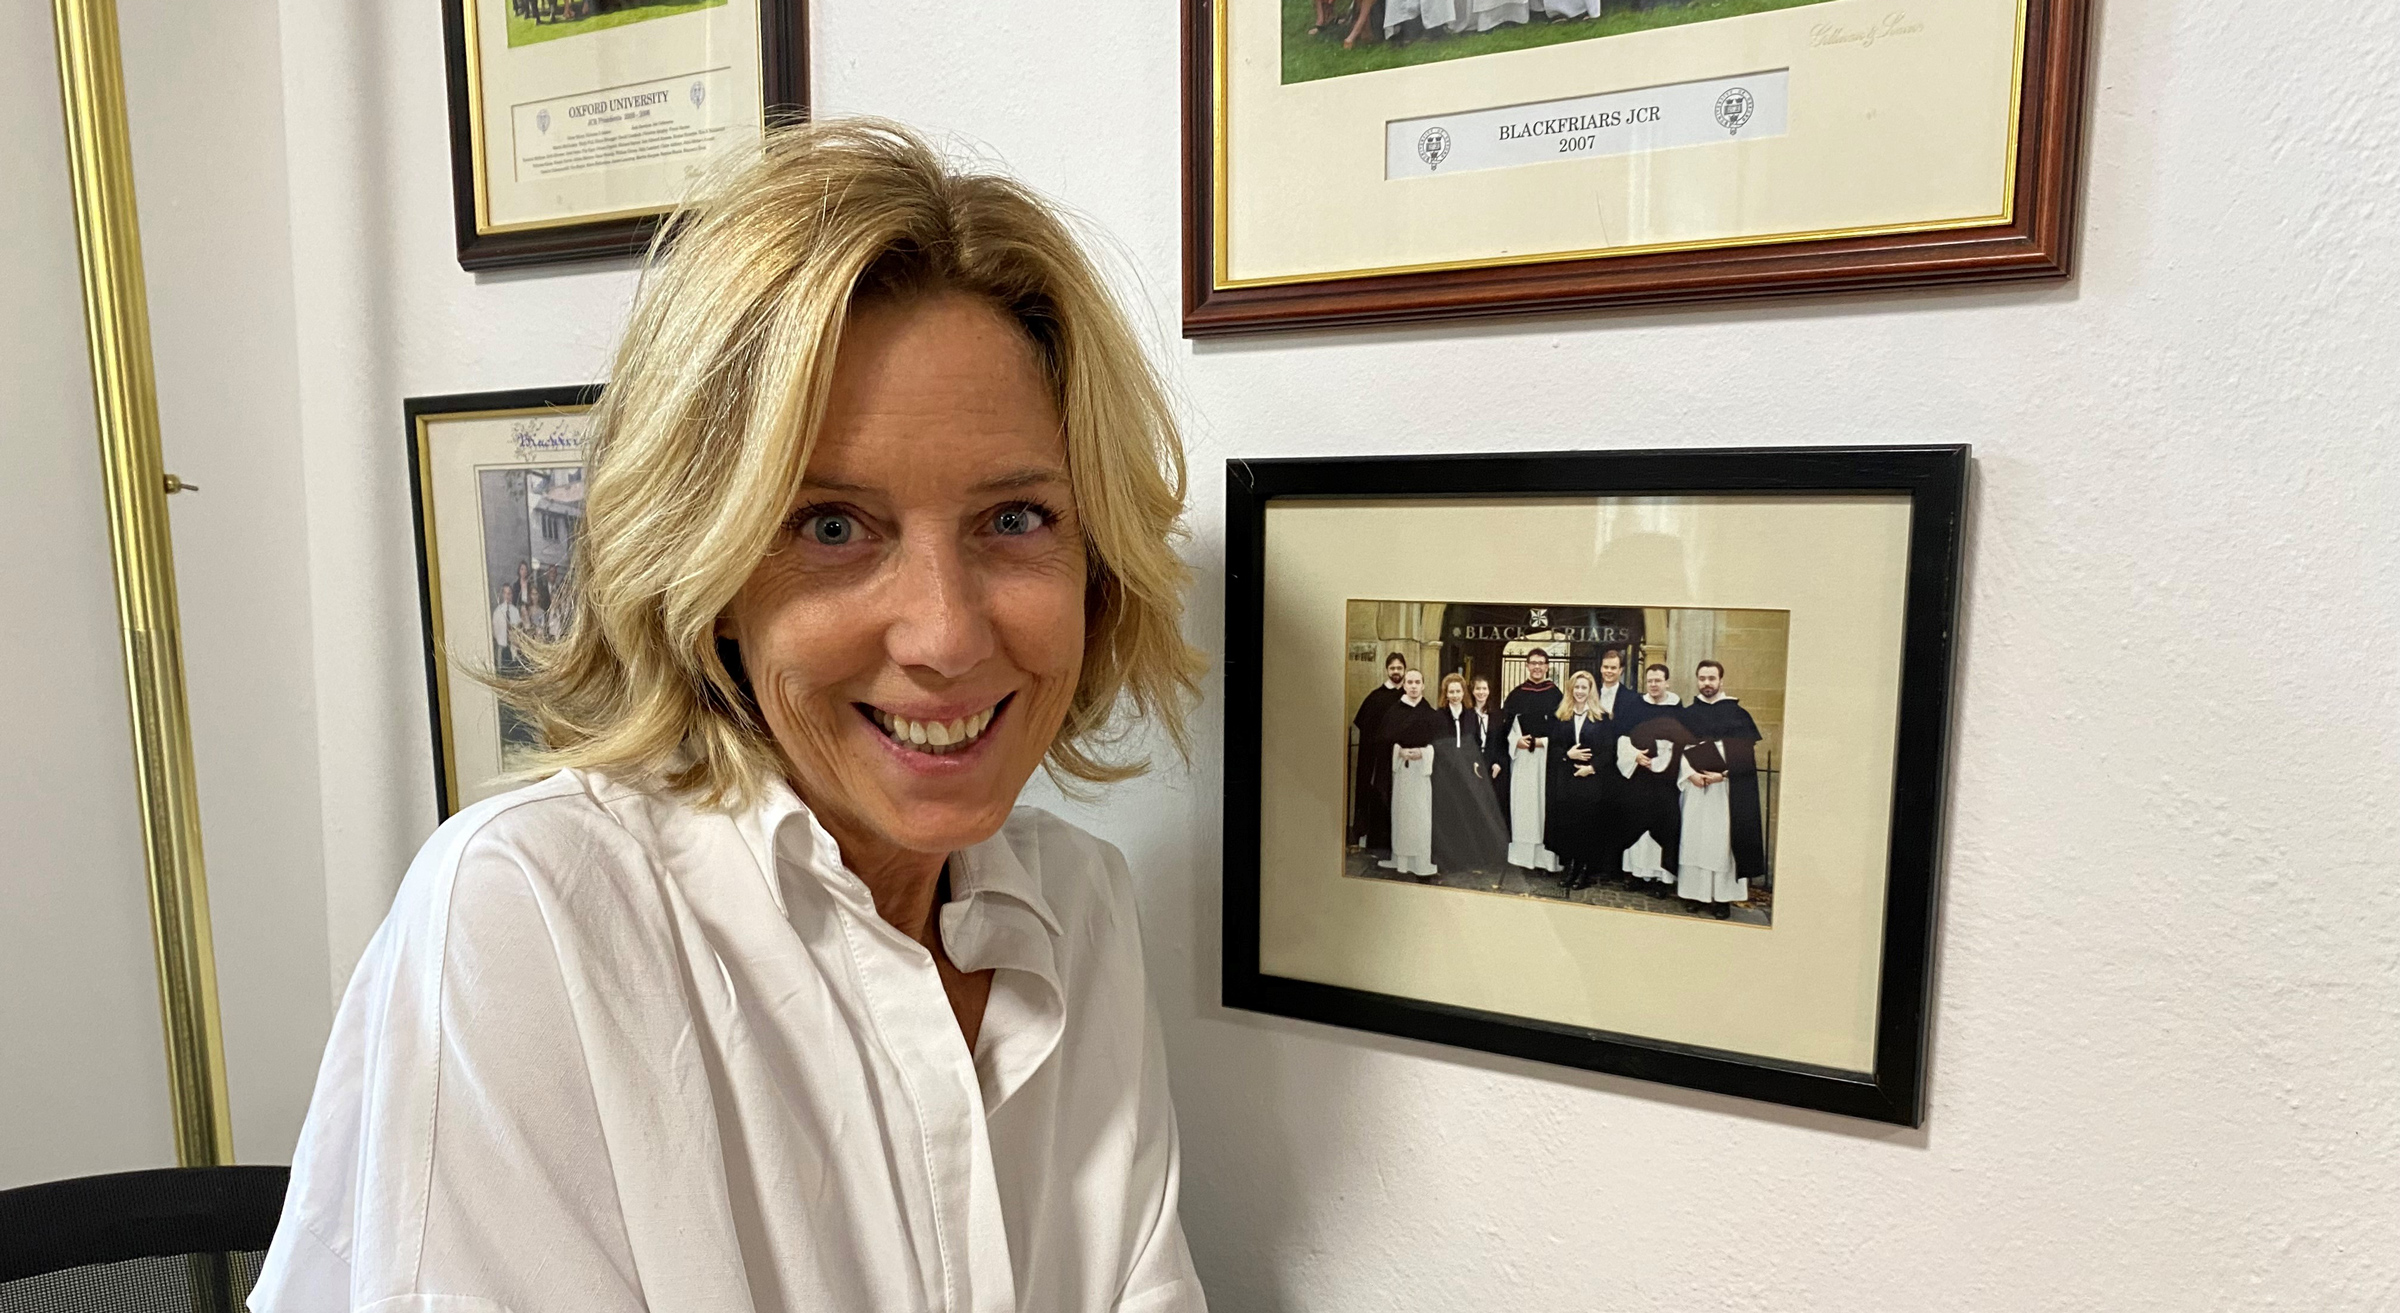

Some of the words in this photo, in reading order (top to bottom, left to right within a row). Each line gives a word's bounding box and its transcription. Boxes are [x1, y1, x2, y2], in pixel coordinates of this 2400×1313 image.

[568, 101, 607, 118] OXFORD
[609, 90, 669, 112] UNIVERSITY
[1499, 110, 1621, 140] BLACKFRIARS
[1626, 106, 1661, 125] JCR
[1559, 135, 1596, 152] 2007
[1465, 625, 1528, 640] BLACK
